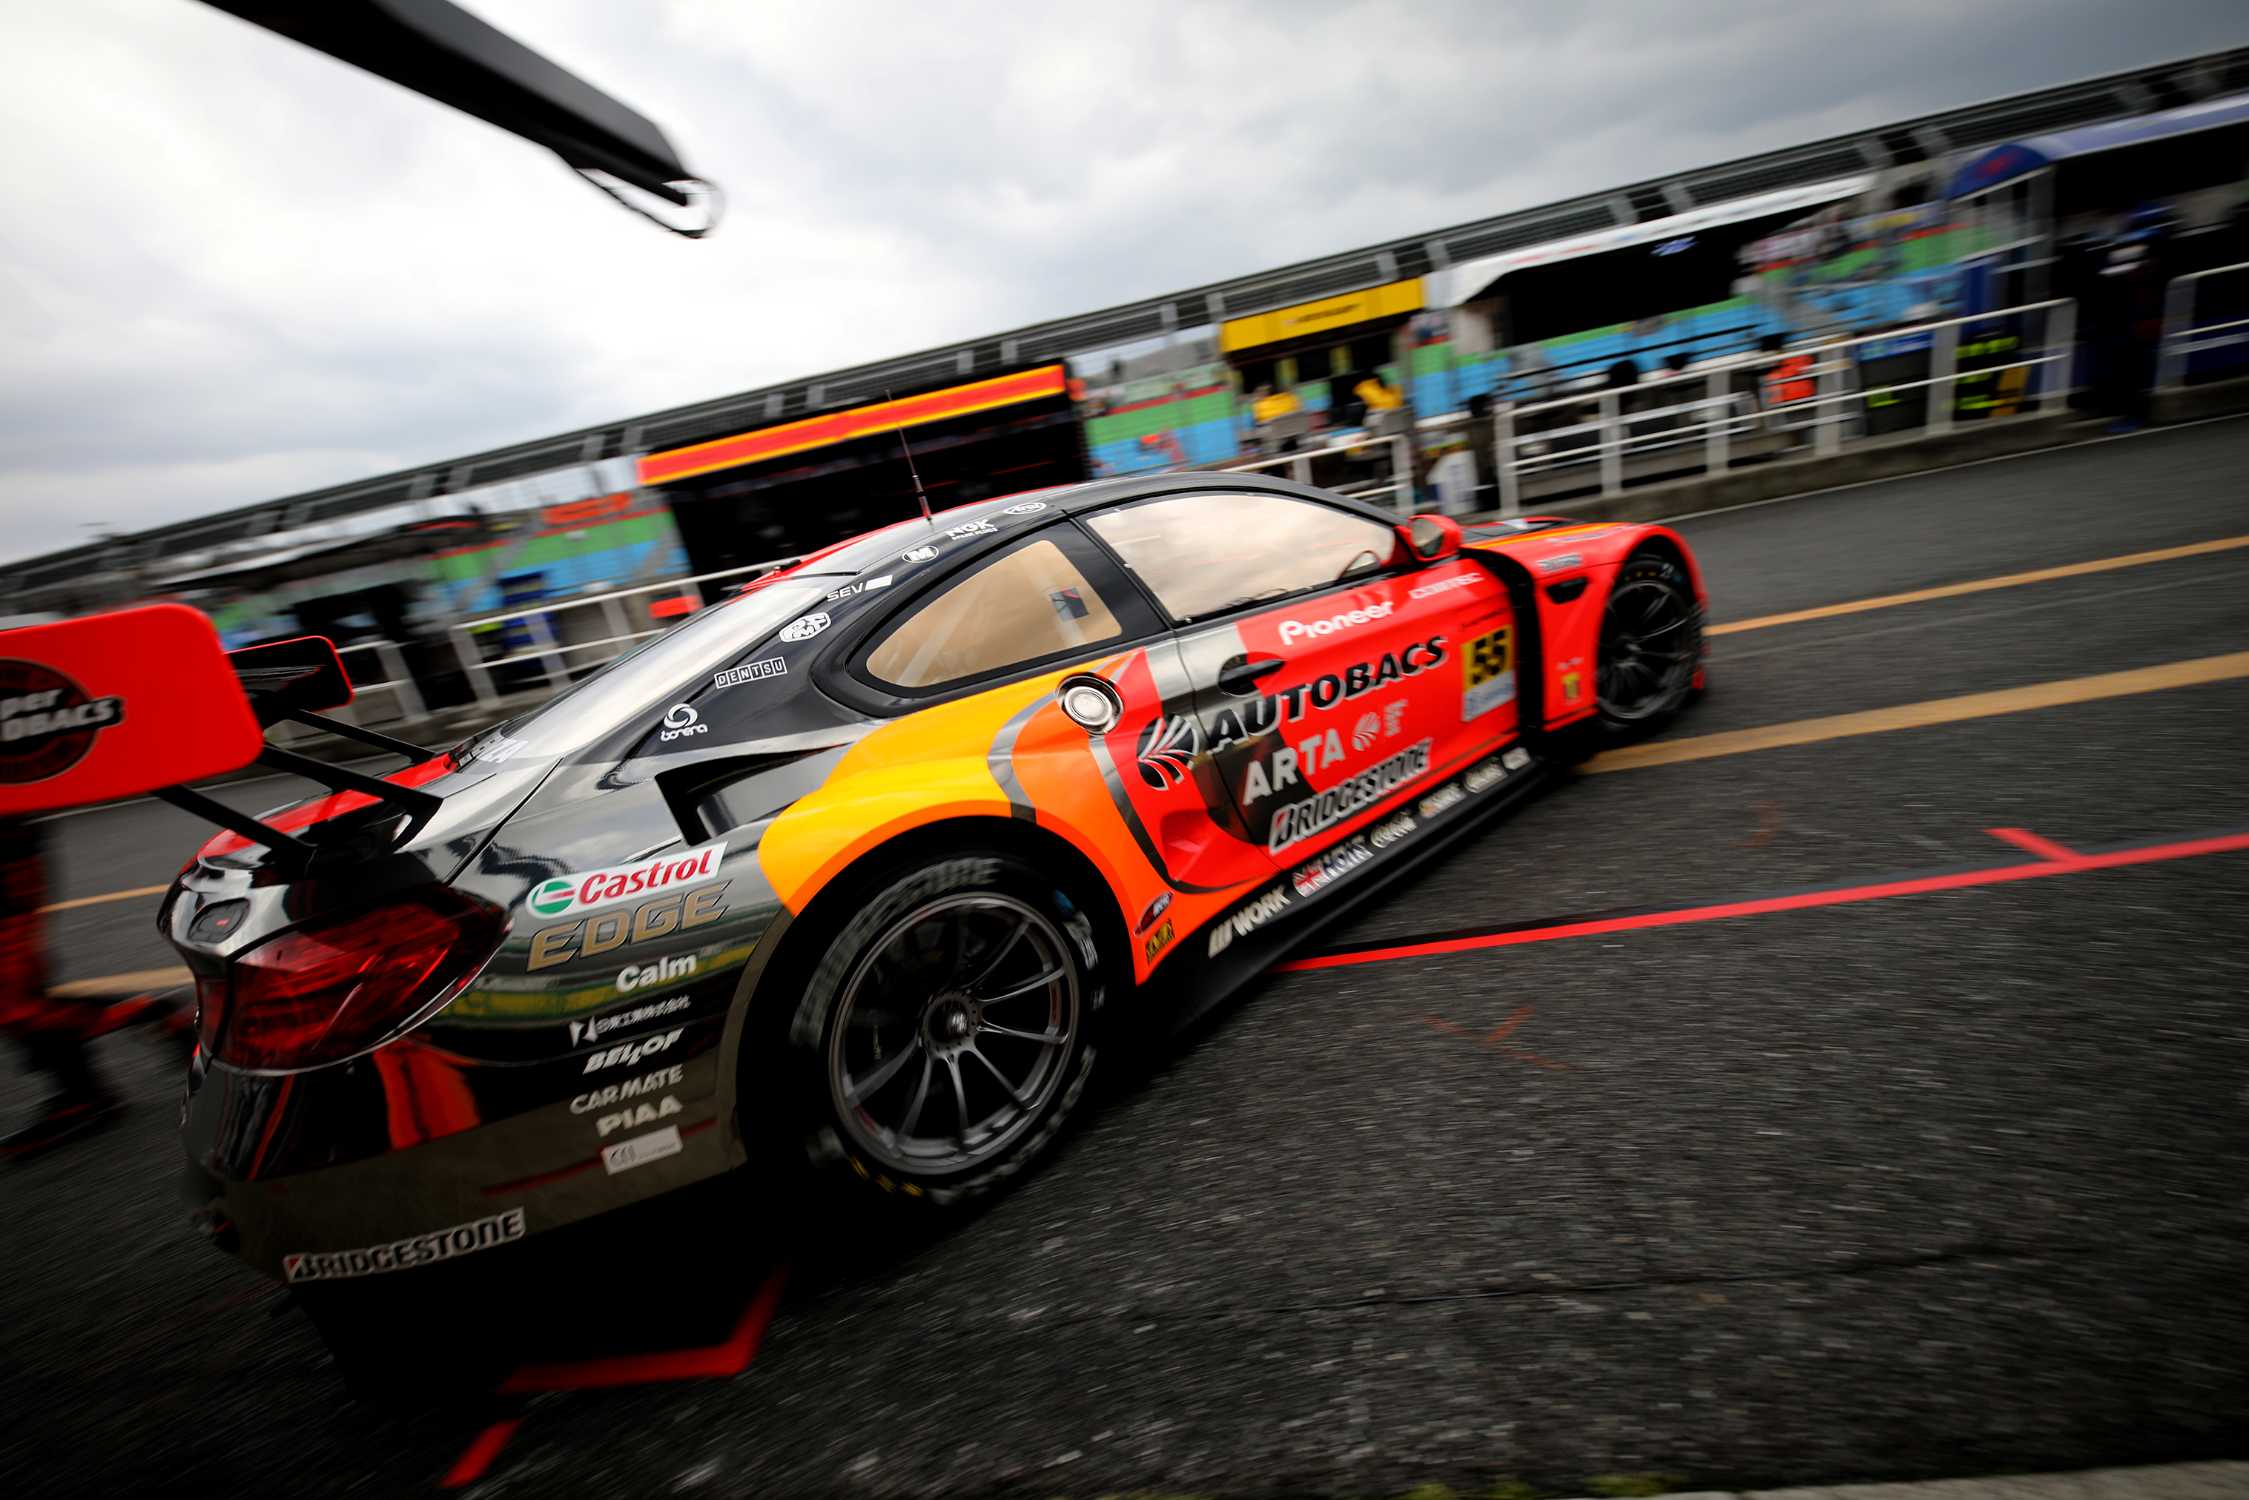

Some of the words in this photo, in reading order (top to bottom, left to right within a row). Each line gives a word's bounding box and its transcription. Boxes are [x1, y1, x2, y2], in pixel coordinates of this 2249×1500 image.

[946, 519, 994, 537] NGK
[827, 582, 863, 601] SEV
[1278, 601, 1394, 646] Pioneer
[715, 657, 787, 689] DENTSU
[1472, 628, 1507, 686] 55
[1206, 636, 1448, 756] AUTOBACS
[1243, 728, 1346, 806] ARTA
[1268, 737, 1433, 857] BRIDGESTONE
[578, 849, 713, 906] Castrol
[527, 880, 736, 973] EDGE
[1231, 884, 1292, 937] WORK
[616, 953, 697, 993] Calm
[569, 1063, 685, 1115] CARMATE
[596, 1095, 684, 1137] PIAA
[283, 1206, 527, 1284] BRIDGESTONE
